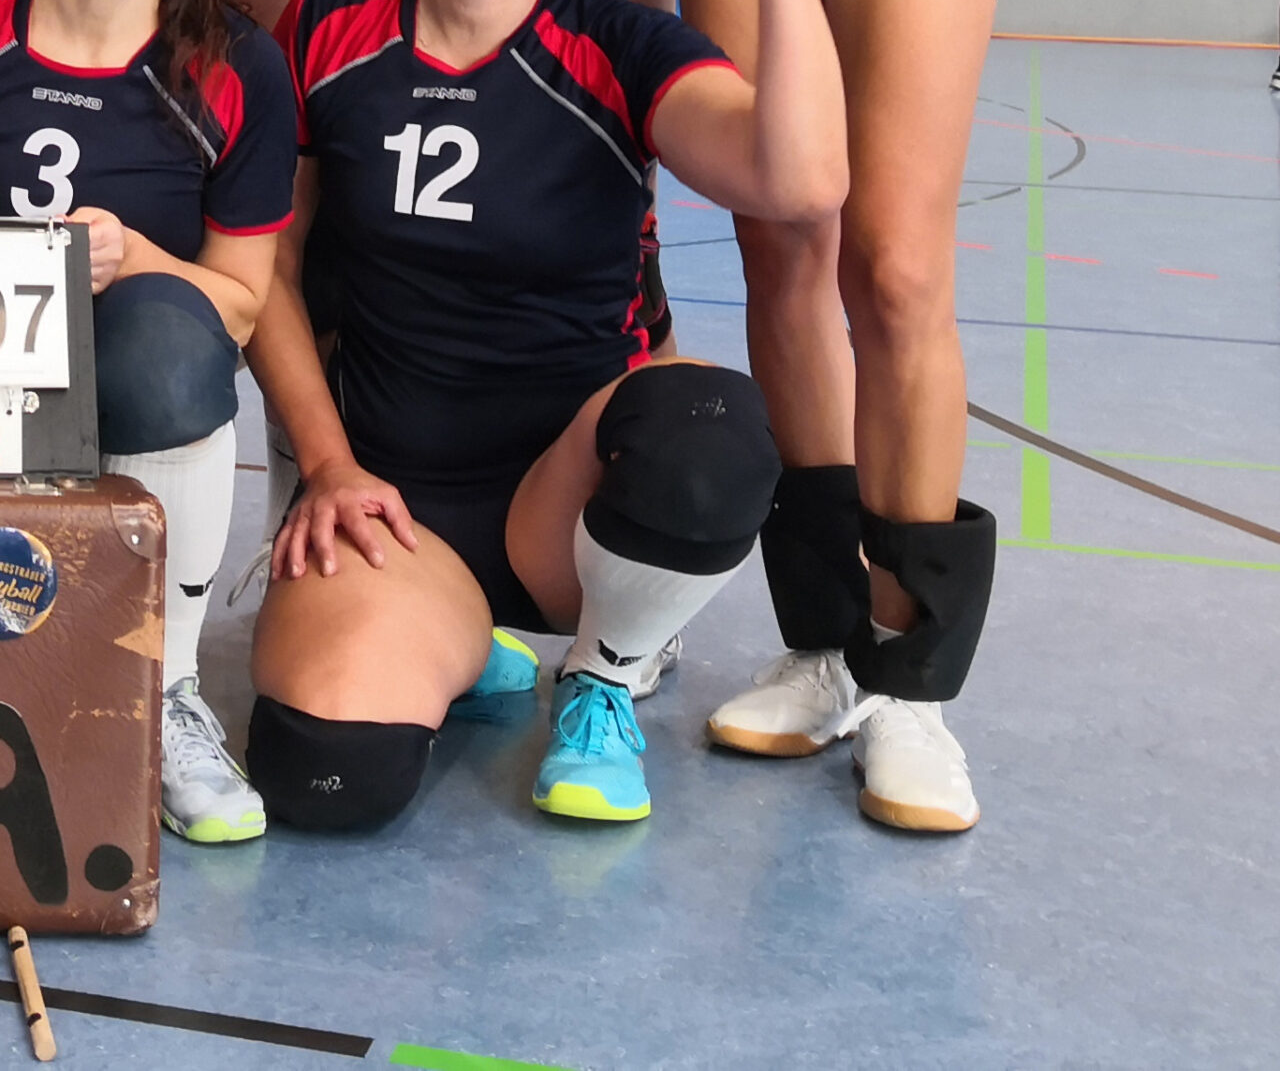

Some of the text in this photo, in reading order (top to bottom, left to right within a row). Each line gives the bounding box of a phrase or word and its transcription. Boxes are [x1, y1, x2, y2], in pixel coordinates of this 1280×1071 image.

[32, 87, 103, 110] STANNO
[413, 87, 477, 102] STANNO
[11, 128, 80, 217] 3
[384, 123, 480, 221] 12
